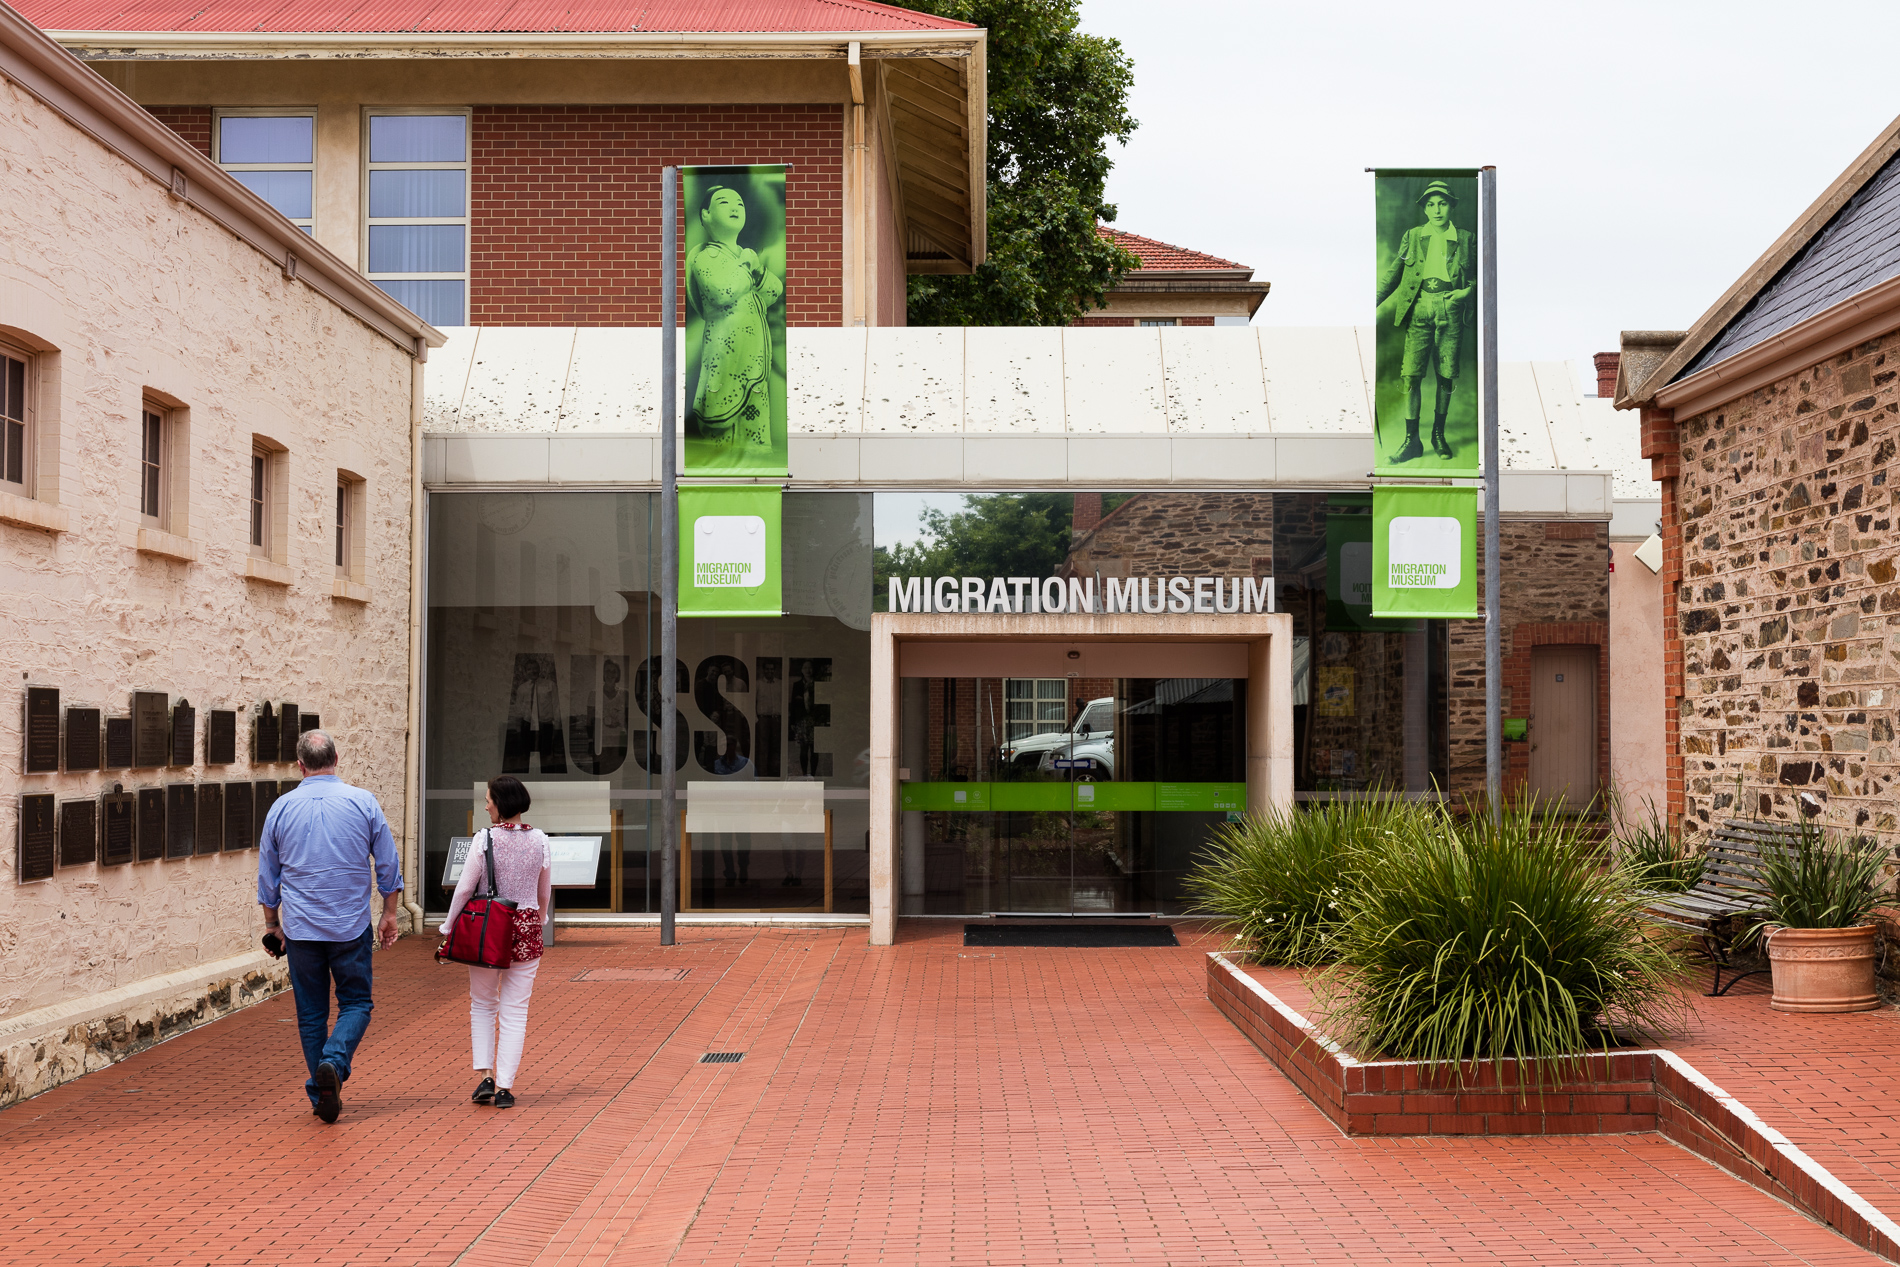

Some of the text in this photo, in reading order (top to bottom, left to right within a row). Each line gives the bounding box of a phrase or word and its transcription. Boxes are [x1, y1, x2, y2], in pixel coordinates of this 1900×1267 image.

[696, 562, 752, 574] MIGRATION
[1391, 563, 1447, 575] MIGRATION
[696, 574, 742, 585] MUSEUM
[1391, 575, 1437, 586] MUSEUM
[888, 576, 1275, 614] MIGRATION MUSEUM
[501, 653, 834, 776] AUSSIE
